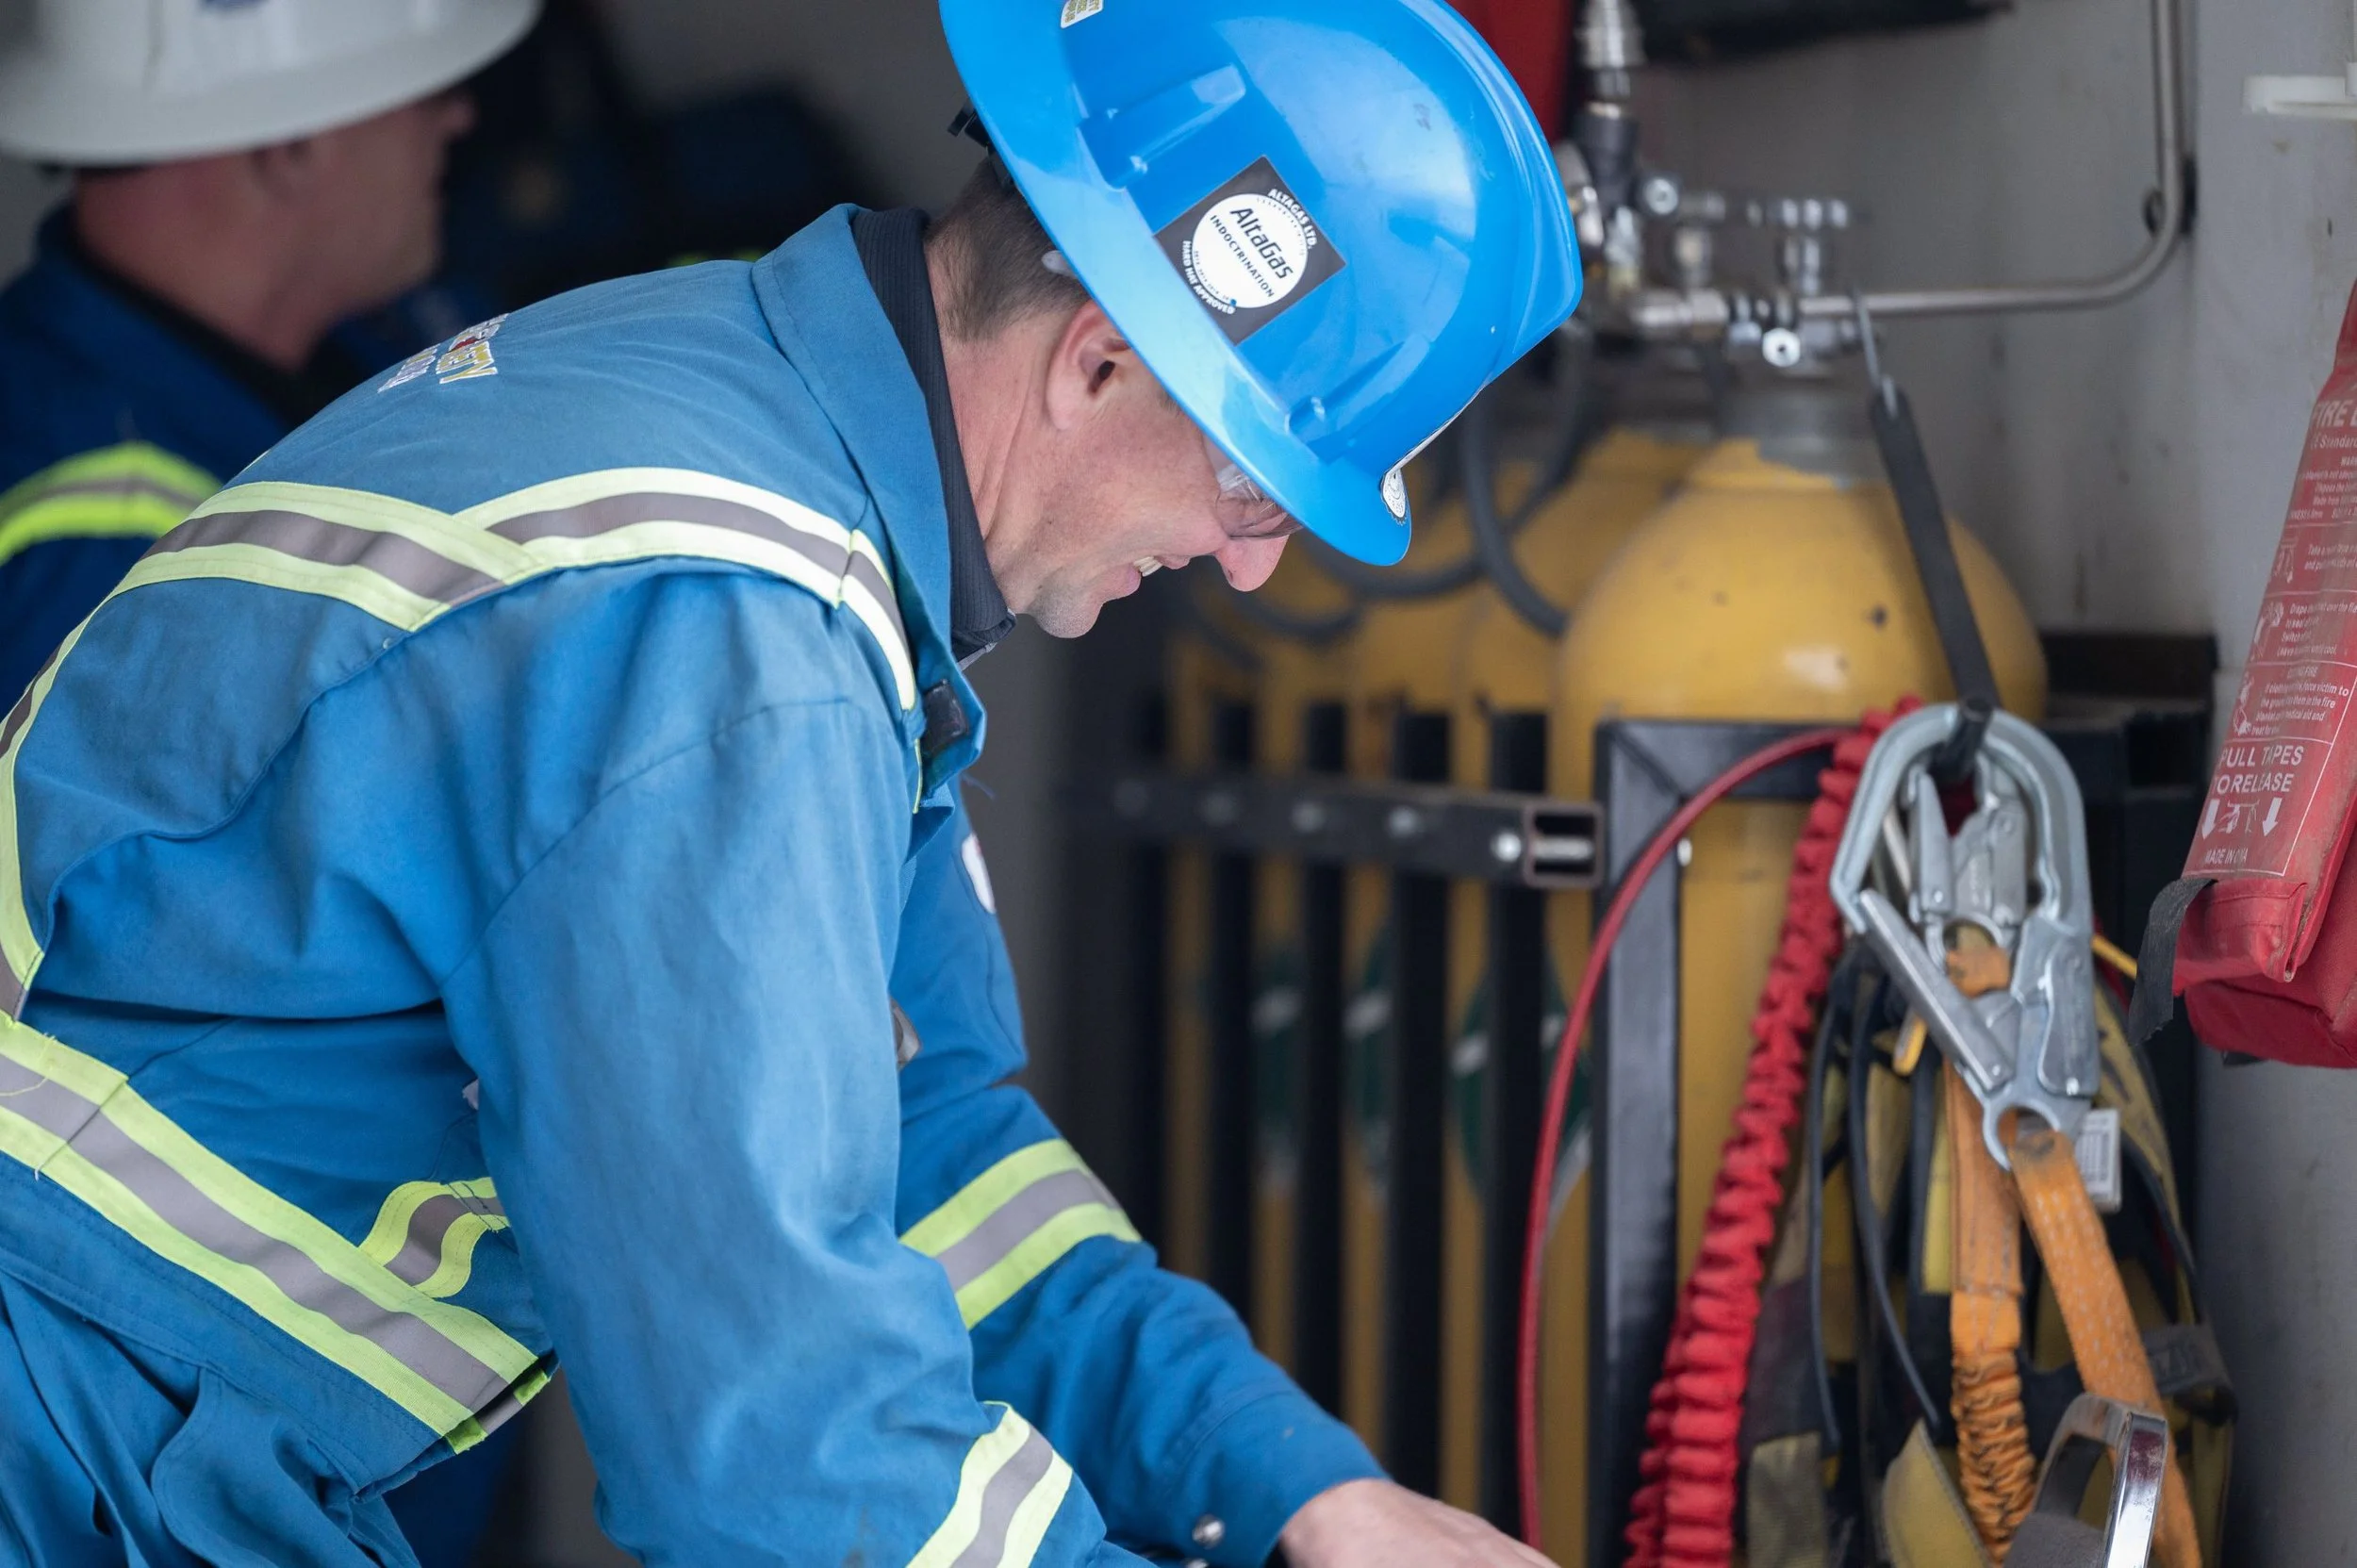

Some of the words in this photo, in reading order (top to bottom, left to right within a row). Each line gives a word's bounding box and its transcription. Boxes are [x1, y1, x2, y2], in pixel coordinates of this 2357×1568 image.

[1267, 188, 1310, 224] ALTAGAS
[1303, 224, 1317, 249] LTD.
[1182, 239, 1193, 267] HARD
[1210, 215, 1275, 297] INDOCTRINATION
[1229, 207, 1294, 279] AltaGas
[1184, 267, 1198, 285] HAT
[1193, 284, 1236, 314] APPROVED
[2316, 681, 2337, 694] victim
[2338, 685, 2349, 697] to
[2321, 696, 2336, 709] fire
[2311, 711, 2326, 722] and
[2220, 746, 2255, 768] PULL
[2261, 744, 2304, 767] TAPES
